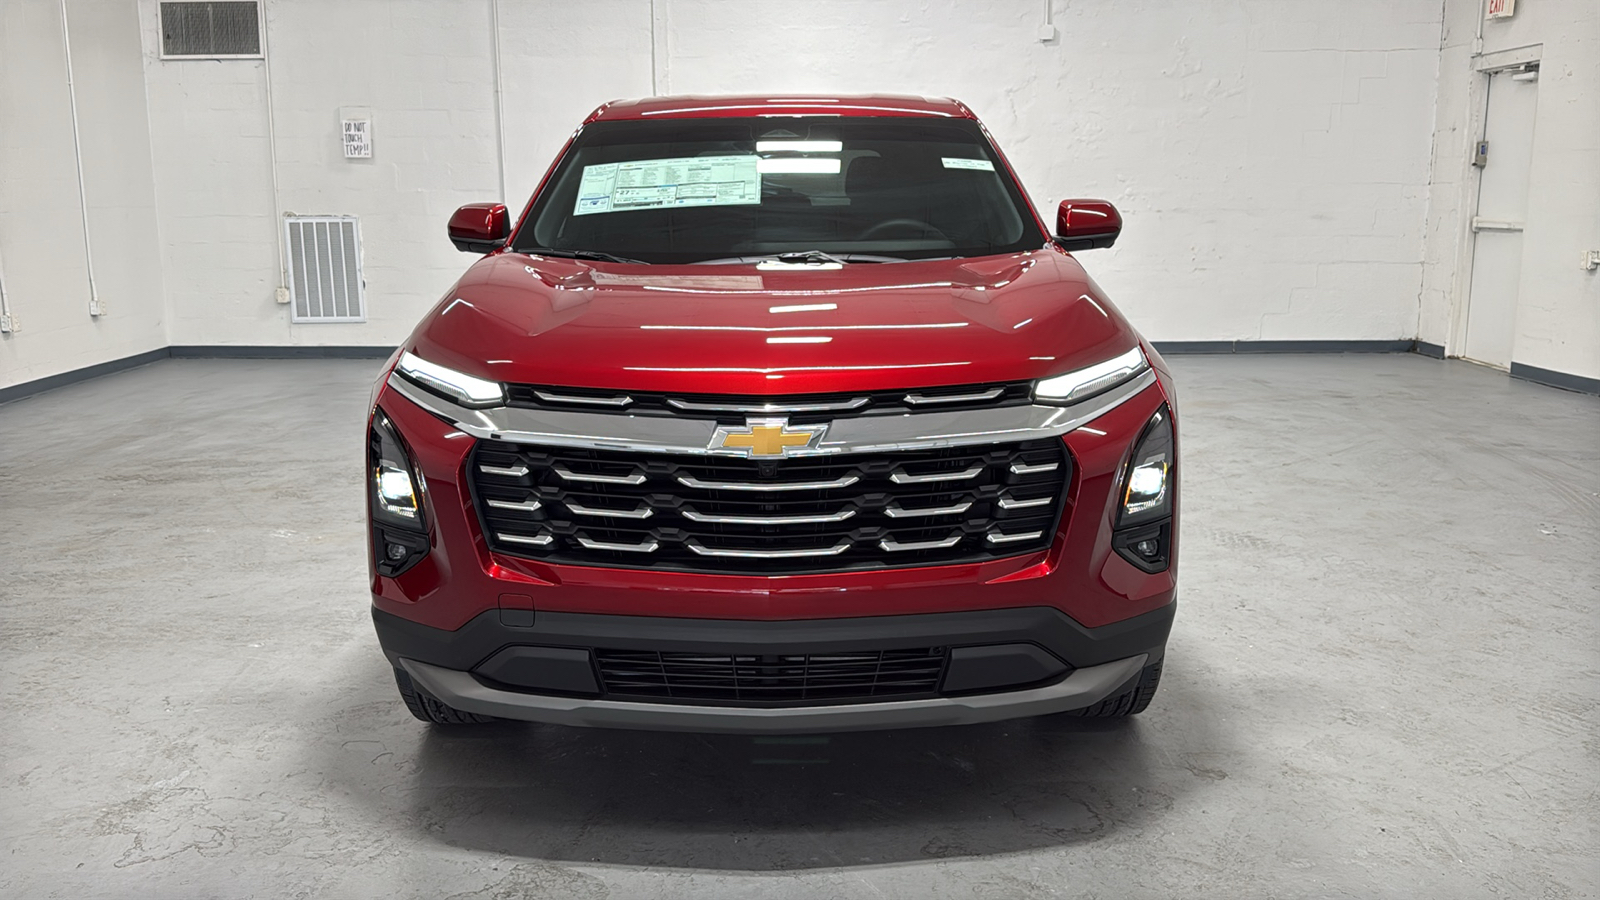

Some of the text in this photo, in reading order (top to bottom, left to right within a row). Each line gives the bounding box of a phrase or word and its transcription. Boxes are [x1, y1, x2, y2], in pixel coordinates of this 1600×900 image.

[344, 122, 366, 133] DO NOT
[344, 133, 363, 143] TOUCH
[345, 143, 370, 156] TEMP!!
